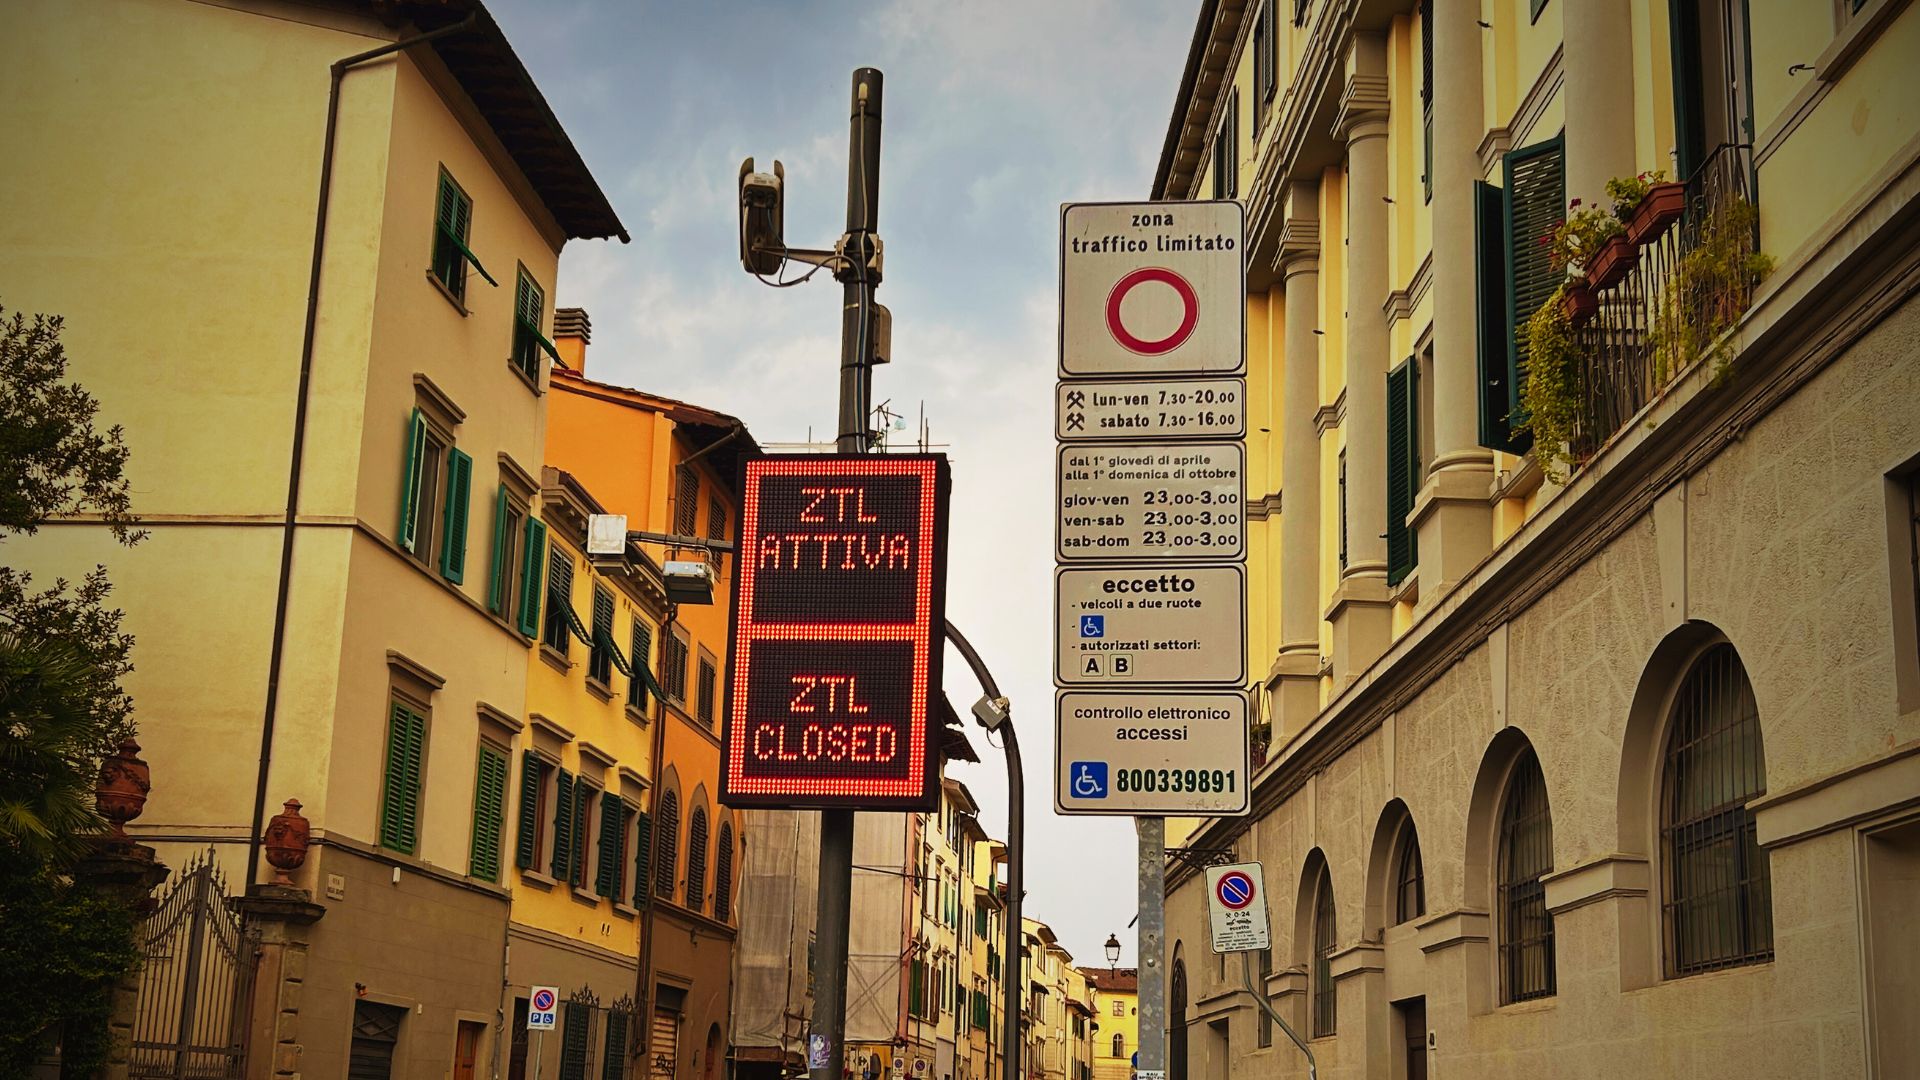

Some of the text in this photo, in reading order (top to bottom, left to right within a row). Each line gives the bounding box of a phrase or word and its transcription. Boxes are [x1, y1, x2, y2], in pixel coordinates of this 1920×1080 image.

[1132, 214, 1173, 226] zona
[1072, 235, 1234, 253] traffico limitato
[1094, 393, 1148, 406] lun-ven
[1101, 414, 1149, 427] sabato
[1070, 457, 1089, 466] dal
[1109, 456, 1153, 467] giovedì
[1158, 455, 1169, 465] di
[1174, 455, 1210, 466] aprile
[1066, 471, 1088, 480] alla
[1109, 470, 1168, 479] domenica
[1174, 469, 1184, 478] di
[1189, 469, 1236, 478] ottobre
[800, 487, 877, 523] ZTL
[1064, 495, 1129, 508] giov-ven
[1064, 514, 1124, 526] ven-sab
[1065, 535, 1129, 547] sab-dom
[760, 534, 909, 570] ATTIVA
[1103, 575, 1194, 593] eccetto
[1081, 600, 1122, 609] veicoli
[1139, 599, 1162, 608] due
[1167, 599, 1201, 608] ruote
[1081, 640, 1200, 650] autorizzati settori:
[1086, 658, 1128, 672] A B
[790, 676, 869, 714] ZTL
[1075, 707, 1230, 719] controllo elettronico
[1117, 726, 1187, 740] accessi
[754, 724, 896, 762] CLOSED
[1117, 769, 1234, 793] 800339891
